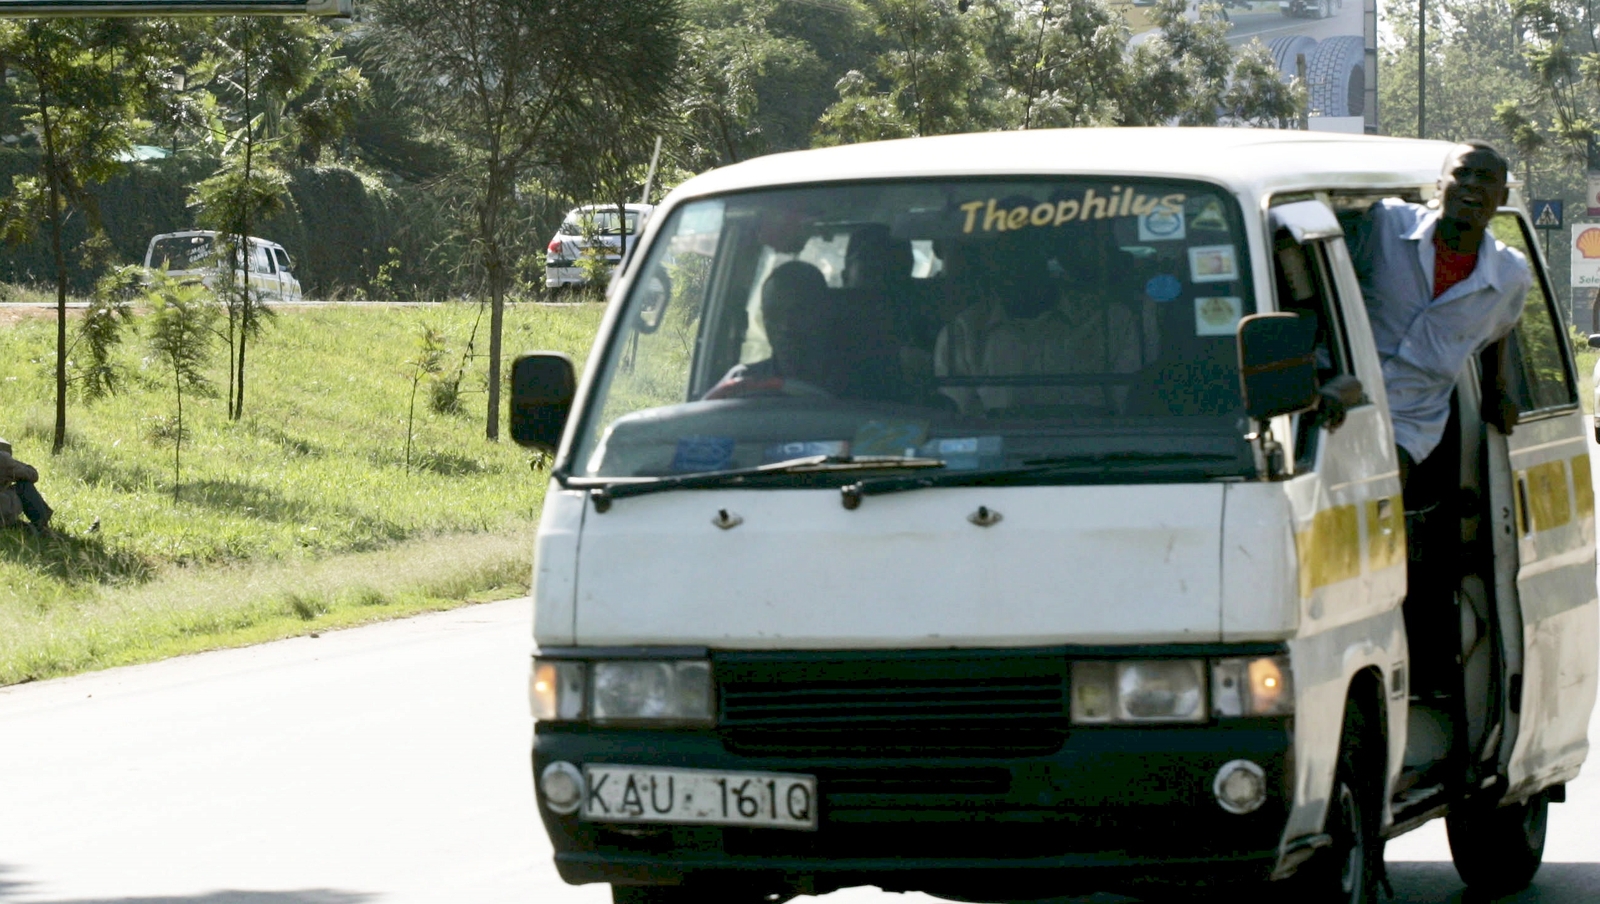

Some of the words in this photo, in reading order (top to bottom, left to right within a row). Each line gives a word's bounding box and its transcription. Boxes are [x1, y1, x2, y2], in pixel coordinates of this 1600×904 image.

[960, 185, 1187, 234] Theophilus
[586, 772, 675, 815] KAU
[717, 777, 811, 821] 161Q
